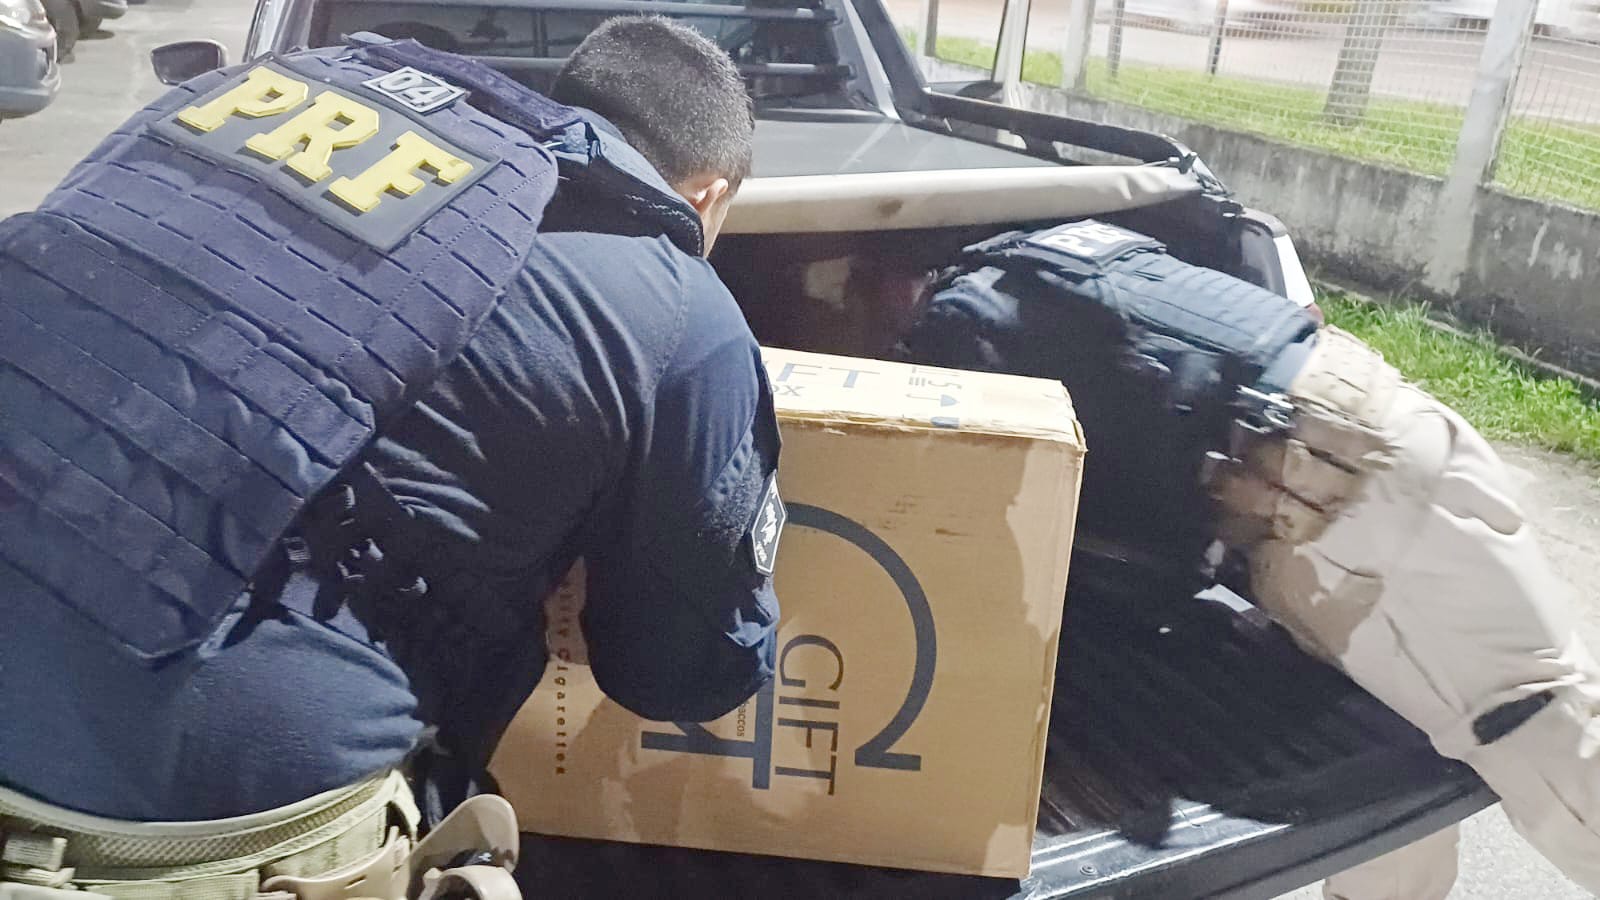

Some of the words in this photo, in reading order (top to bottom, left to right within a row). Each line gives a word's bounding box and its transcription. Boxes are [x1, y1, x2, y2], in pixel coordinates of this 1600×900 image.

[380, 72, 449, 102] 04
[177, 65, 474, 213] PRF
[762, 360, 880, 389] FT
[775, 634, 844, 796] GIFT
